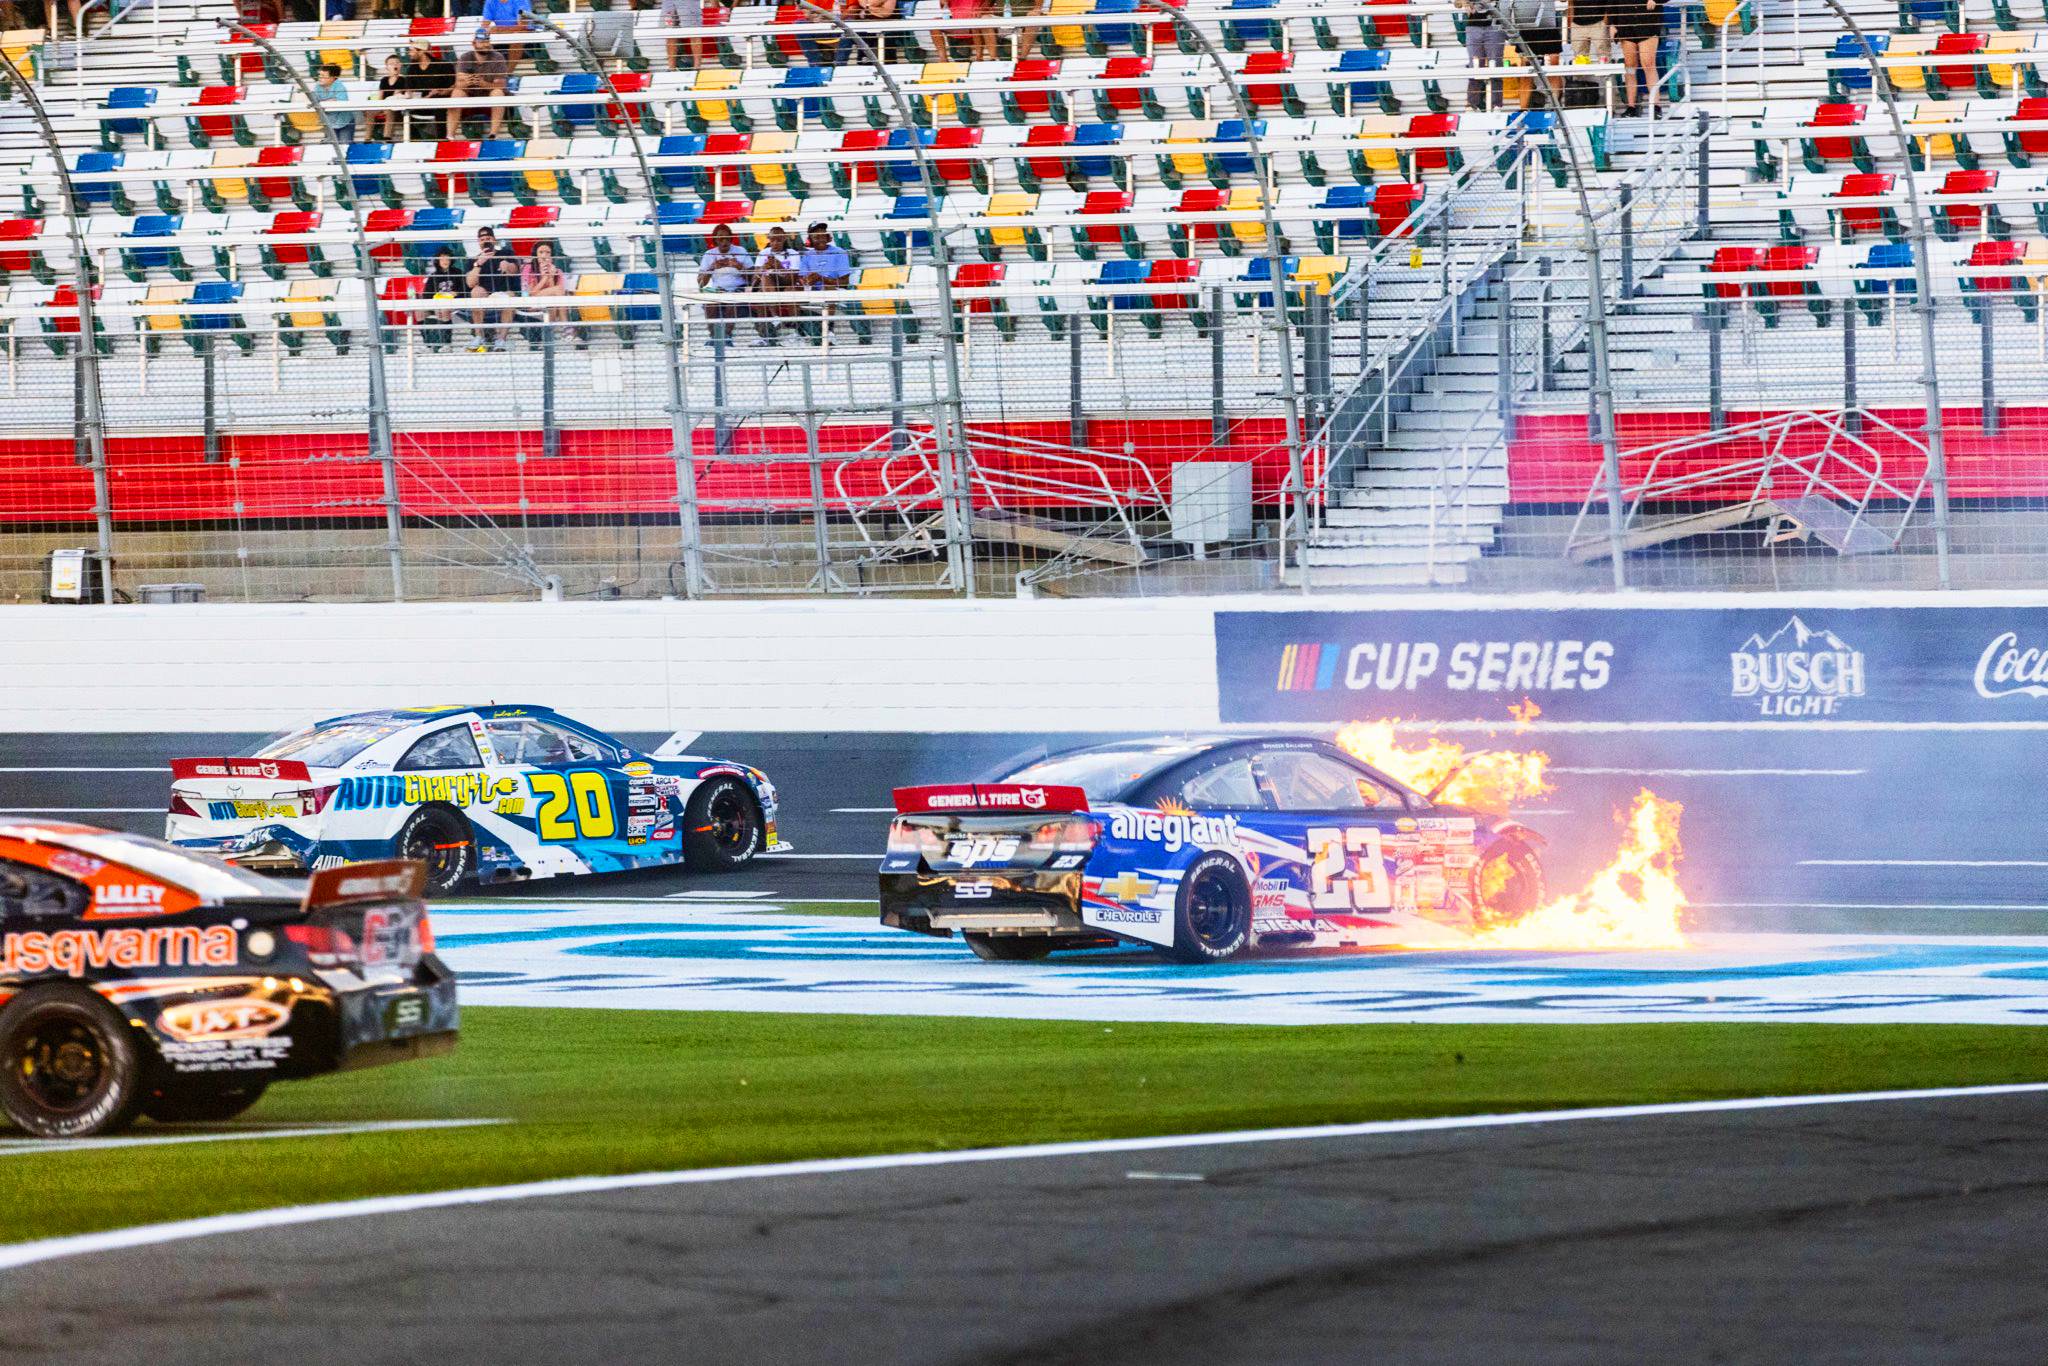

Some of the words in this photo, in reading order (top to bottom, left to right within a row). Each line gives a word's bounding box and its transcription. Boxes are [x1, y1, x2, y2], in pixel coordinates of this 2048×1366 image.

[1345, 643, 1440, 690] CUP
[1446, 640, 1615, 690] SERIES
[1730, 650, 1866, 697] BUSCH
[1759, 696, 1836, 715] LIGHT
[195, 764, 239, 775] GENERAL
[238, 765, 262, 776] TIRE
[655, 776, 672, 785] ARCA
[527, 770, 616, 841] 20
[928, 793, 985, 807] GENERAL
[986, 793, 1021, 805] TIRE
[1109, 810, 1239, 853] allegiant
[1190, 857, 1236, 882] GENERAL
[1307, 826, 1393, 914] 23
[94, 885, 166, 904] LILLEY
[1255, 881, 1279, 891] Mobil
[1254, 894, 1286, 907] GMS
[1096, 909, 1162, 923] CHEVROLET
[1200, 932, 1245, 957] GENERAL
